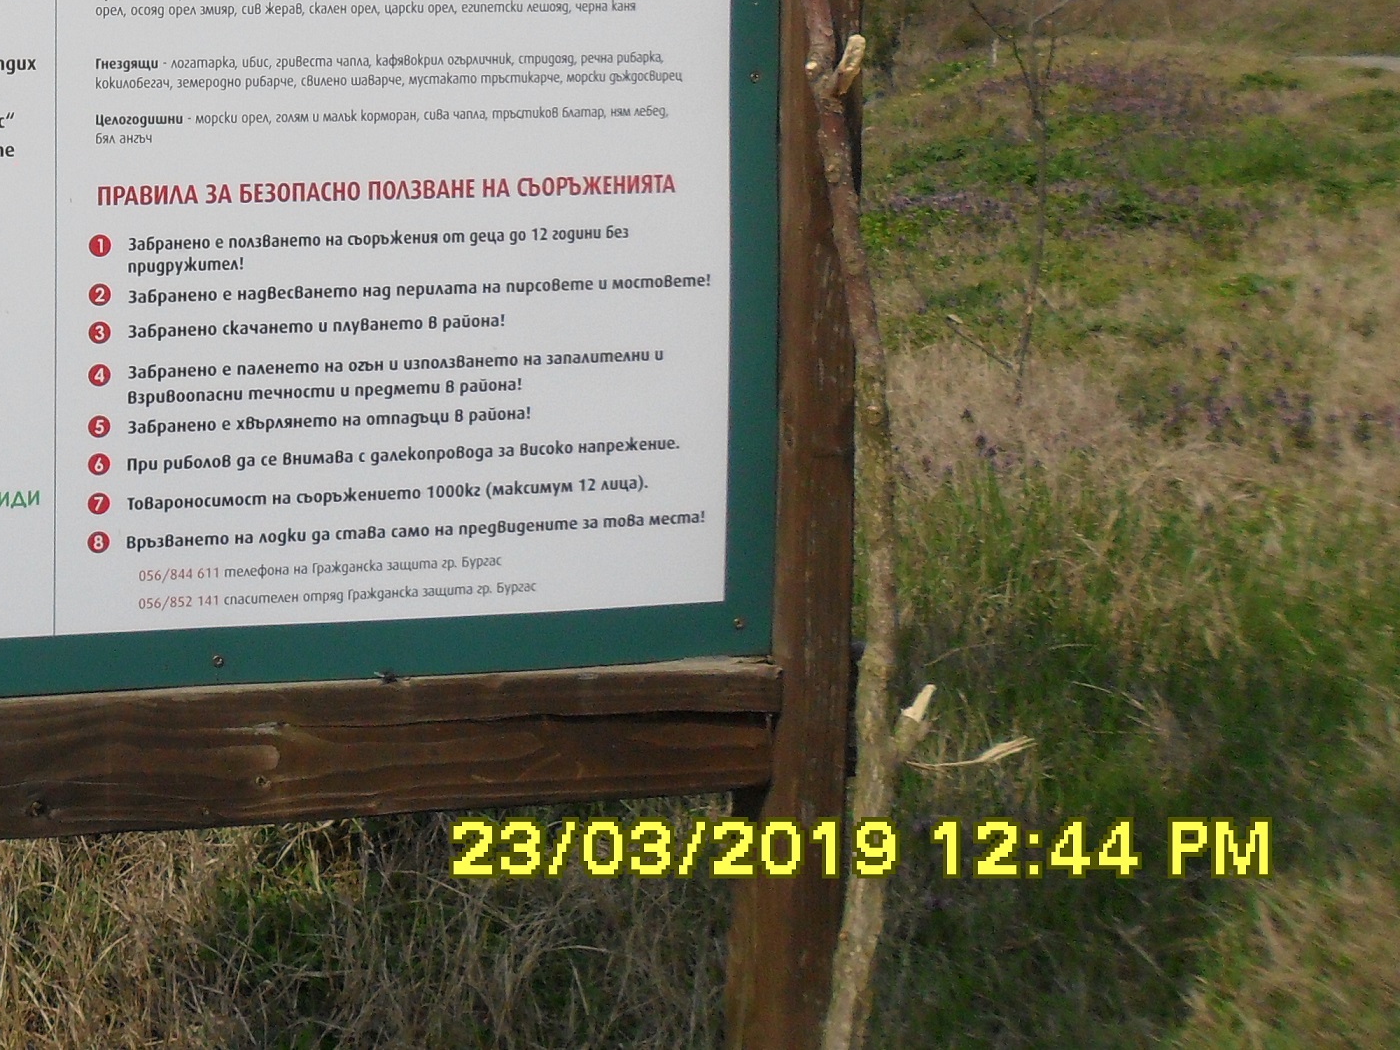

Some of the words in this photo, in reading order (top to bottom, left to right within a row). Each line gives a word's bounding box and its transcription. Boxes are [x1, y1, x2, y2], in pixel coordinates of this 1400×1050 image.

[245, 75, 297, 91] рибарче,
[300, 74, 348, 87] свилено
[350, 73, 405, 89] шаварче,
[407, 71, 478, 89] мустакато
[565, 69, 607, 86] морски
[95, 132, 116, 145] бял
[119, 133, 153, 145] ангъч
[97, 184, 199, 207] ПРАВИЛА
[205, 183, 233, 205] ЗА
[239, 181, 361, 204] БЕЗОПАСНО
[367, 178, 475, 201] ПОЛЗВАНЕ
[482, 177, 511, 199] НА
[516, 173, 676, 197] СЪОРЪЖЕНИЯТА
[128, 235, 211, 255] Забранено
[214, 237, 225, 249] е
[228, 233, 321, 249] ползването
[325, 235, 344, 247] на
[347, 229, 439, 249] съоръжения
[442, 231, 465, 244] от
[469, 231, 505, 247] деца
[509, 230, 527, 246] до
[531, 227, 549, 241] 12
[551, 228, 602, 244] години
[605, 224, 629, 239] без
[127, 255, 244, 277] придружител!
[127, 323, 218, 342] Забранено
[222, 319, 314, 336] скачането
[318, 321, 328, 333] и
[333, 317, 424, 336] плуването
[428, 315, 438, 330] в
[442, 313, 505, 333] района!
[127, 418, 217, 437] Забранено
[221, 419, 231, 431] е
[235, 415, 338, 433] хвърлянето
[342, 415, 361, 427] на
[365, 411, 449, 428] отпадъци
[454, 408, 464, 423] в
[468, 405, 531, 426] района!
[138, 567, 193, 584] 056/844
[197, 567, 219, 579] 611
[223, 563, 290, 580] телефона
[293, 564, 308, 575] на
[311, 559, 383, 577] Гражданска
[386, 559, 438, 572] защита
[441, 559, 458, 572] гр.
[461, 555, 502, 570] Бургас
